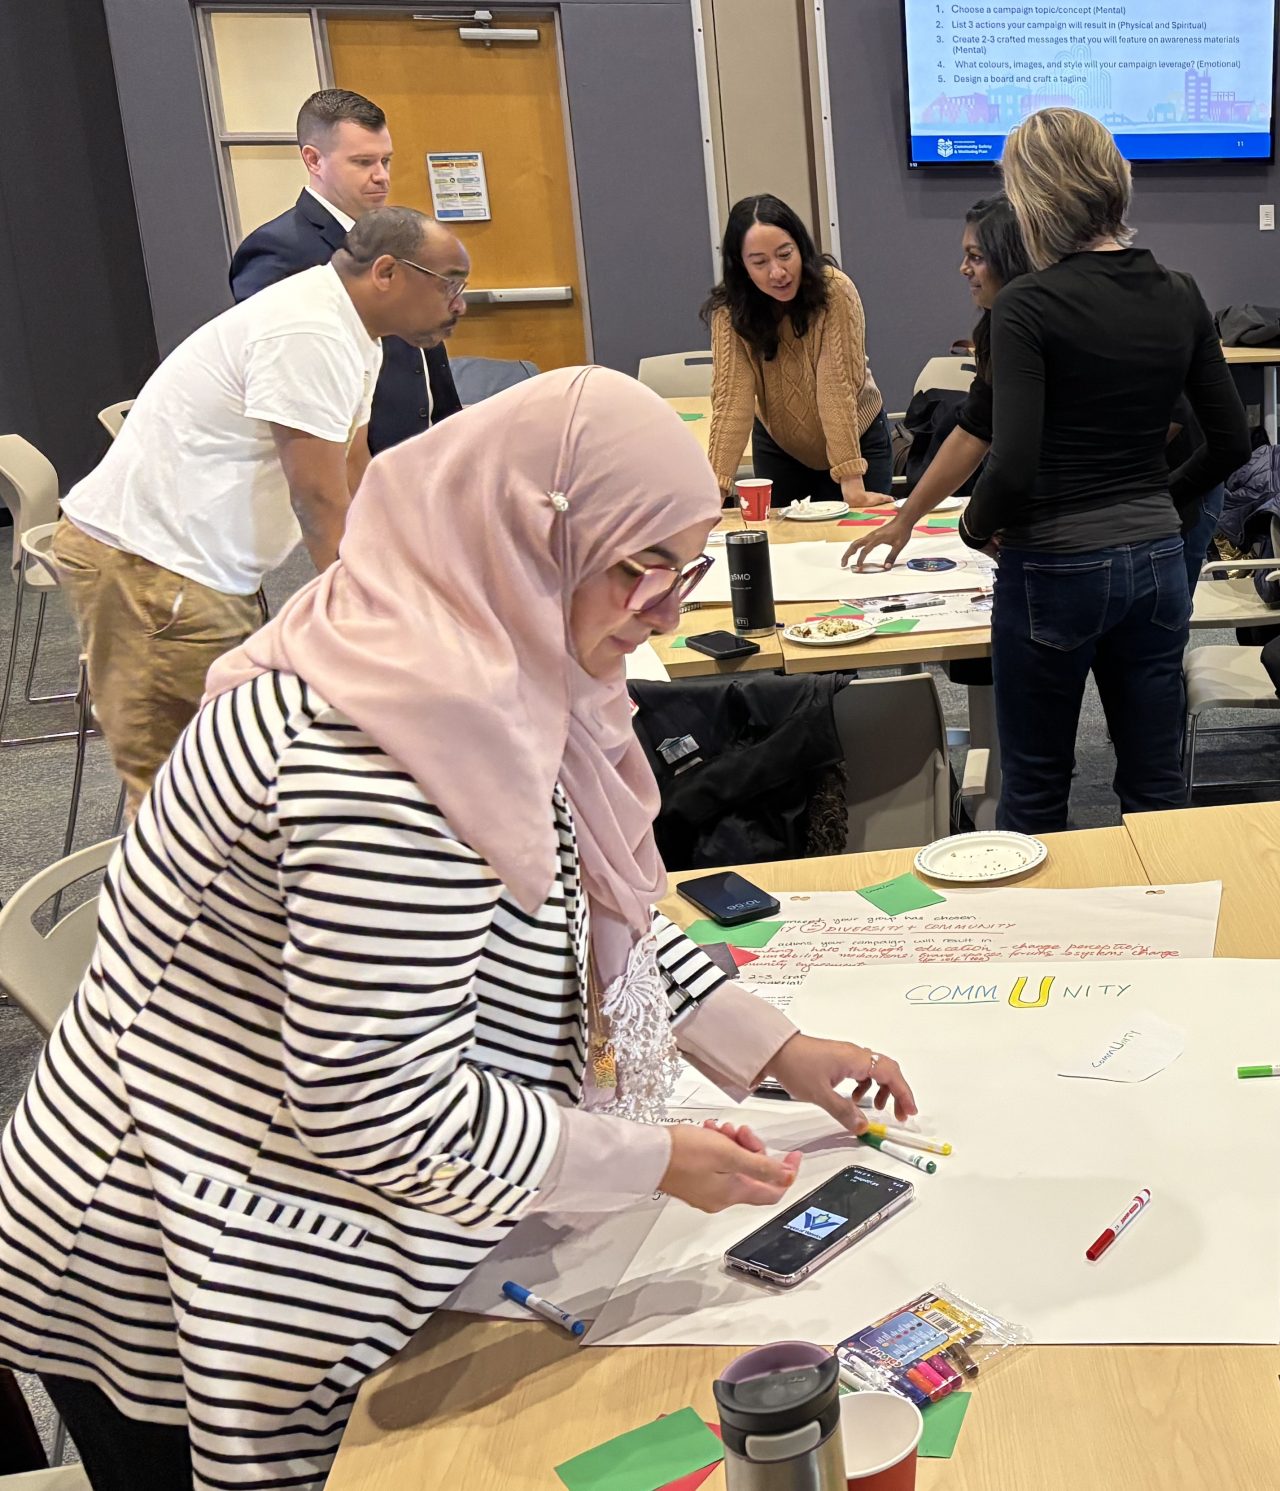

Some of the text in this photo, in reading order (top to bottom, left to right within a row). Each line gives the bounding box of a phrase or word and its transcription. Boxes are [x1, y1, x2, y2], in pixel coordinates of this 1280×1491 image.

[952, 5, 984, 13] Choose
[993, 6, 1033, 16] campaign
[1035, 6, 1091, 15] topic/concept
[1093, 7, 1126, 15] (Mental)
[1027, 22, 1066, 30] campaign
[1118, 22, 1153, 30] (Physical
[1172, 22, 1207, 30] Spiritual)
[952, 46, 986, 55] (Mental)
[978, 61, 1012, 69] colours,
[1013, 61, 1044, 70] images,
[1064, 61, 1082, 69] style
[1118, 62, 1157, 70] campaign
[1158, 61, 1195, 70] leverage?
[1196, 61, 1240, 69] (Emotional)
[954, 75, 981, 84] Design
[1060, 76, 1086, 84] tagline
[849, 947, 904, 955] through
